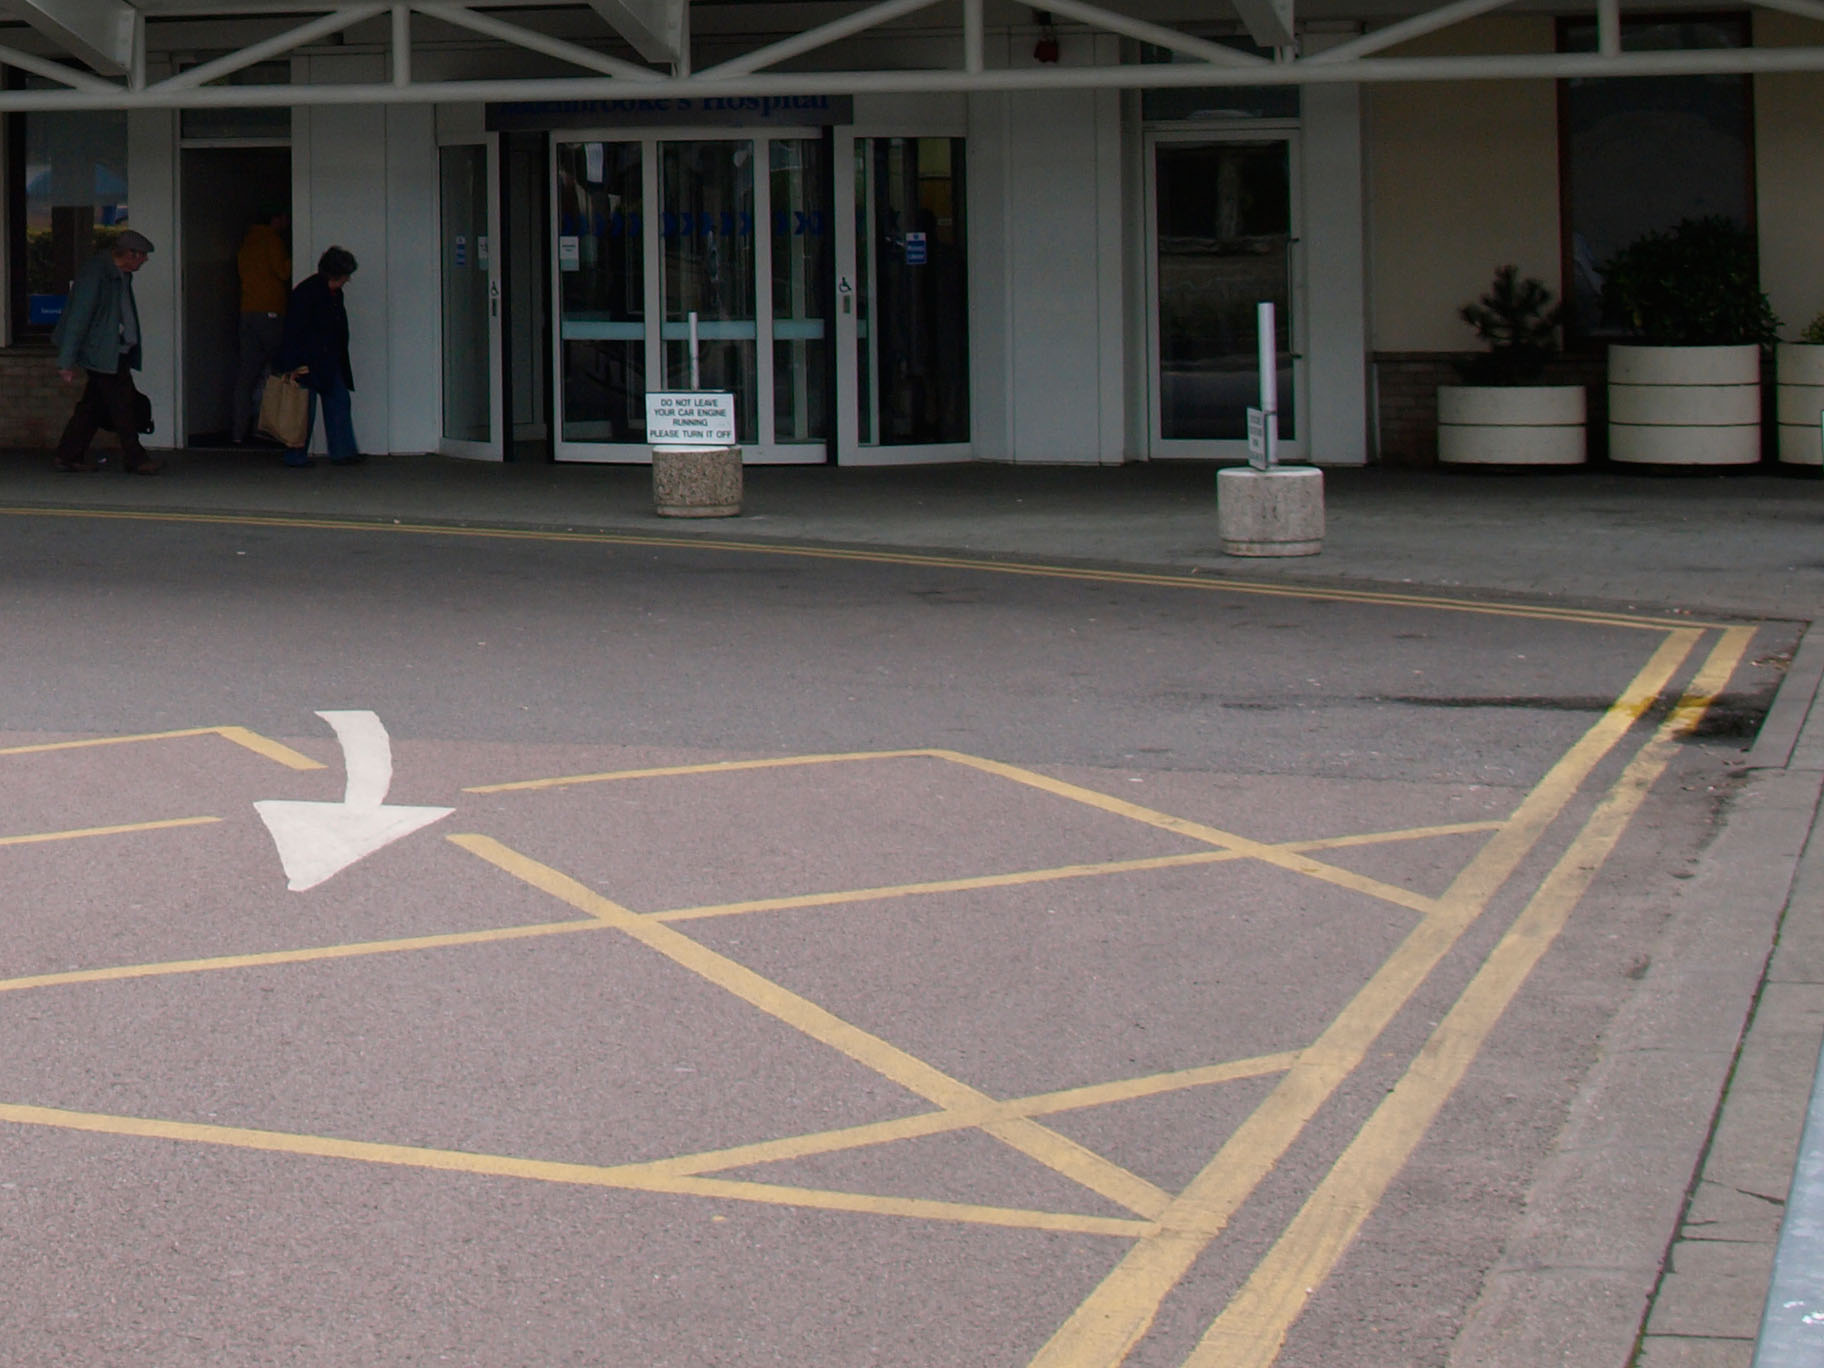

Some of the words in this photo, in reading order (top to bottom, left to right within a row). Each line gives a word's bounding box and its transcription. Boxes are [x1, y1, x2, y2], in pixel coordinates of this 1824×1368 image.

[694, 399, 718, 407] LEAVE
[698, 409, 726, 417] ENGINE
[672, 418, 708, 426] RUNNING
[650, 430, 679, 438] PLEASE
[682, 430, 703, 438] TURN
[716, 430, 732, 438] OFF
